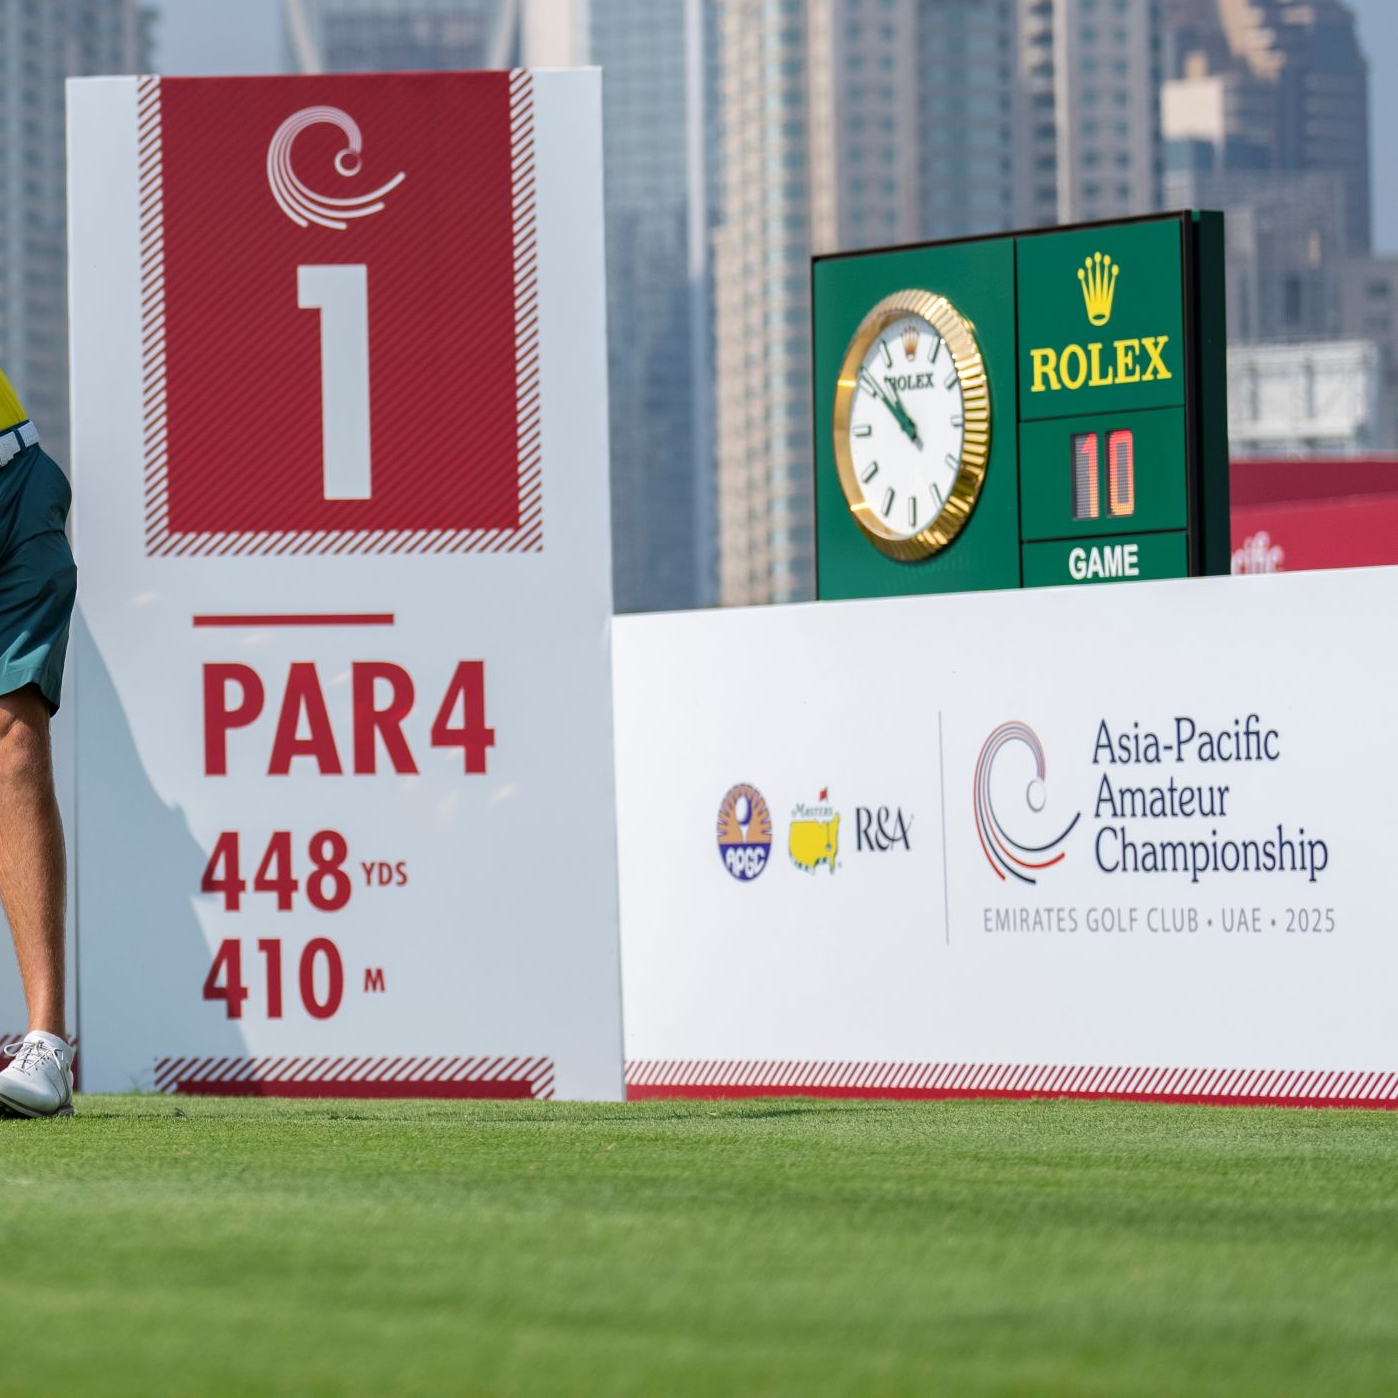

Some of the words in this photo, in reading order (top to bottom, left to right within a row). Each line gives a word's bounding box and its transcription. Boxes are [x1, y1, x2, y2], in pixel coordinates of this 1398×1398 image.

[297, 263, 372, 501] 1
[1030, 336, 1172, 392] ROLEX
[1077, 429, 1135, 519] 10
[1068, 544, 1139, 580] GAME
[1092, 713, 1281, 764] Asia-Pacific
[1094, 772, 1230, 818] Amateur
[200, 829, 352, 914] 448
[361, 861, 409, 888] YDS
[726, 846, 765, 879] APGC
[856, 806, 912, 852] R&A
[1095, 824, 1329, 883] Championship
[983, 907, 1079, 934] EMIRATES
[1086, 907, 1139, 934] GOLF
[1146, 907, 1199, 934] CLUB
[1222, 907, 1263, 934] UAE
[1285, 907, 1336, 934] 2025
[202, 935, 344, 1022] 410
[363, 967, 386, 994] M
